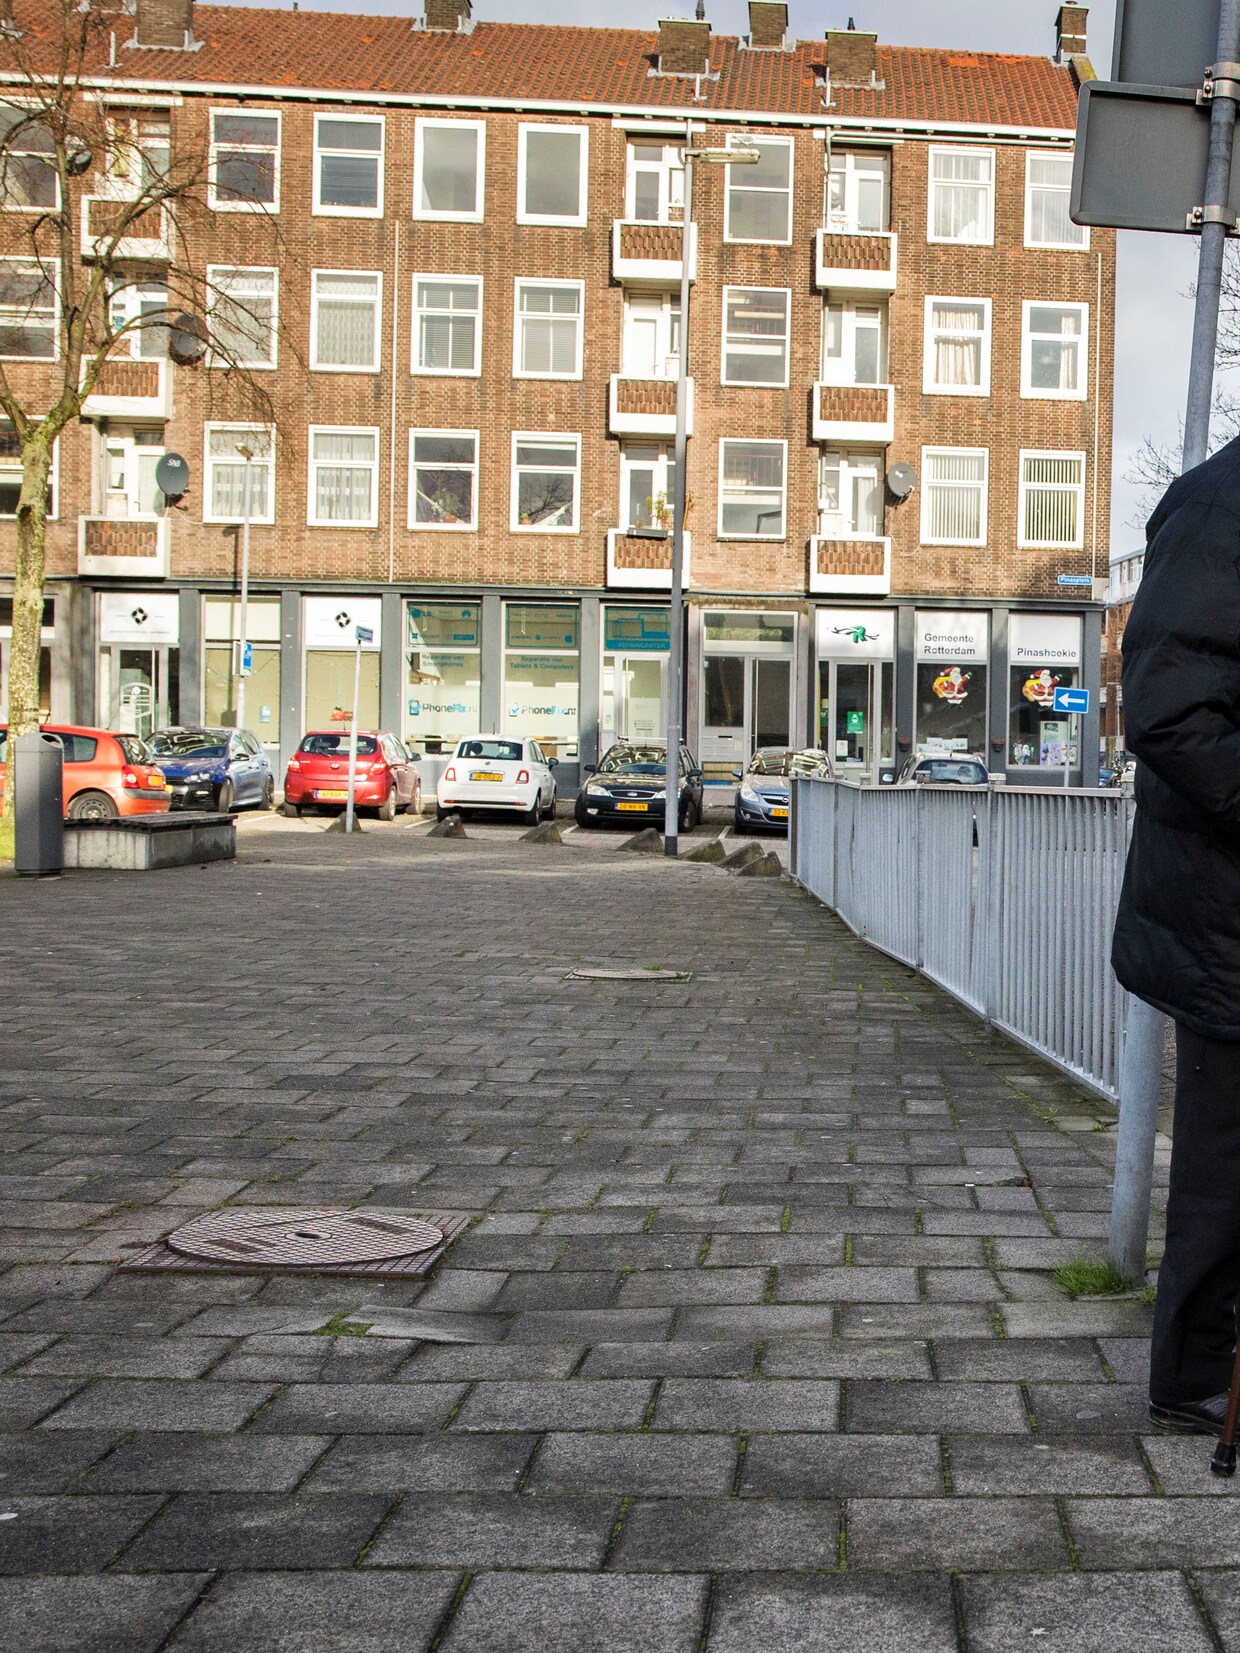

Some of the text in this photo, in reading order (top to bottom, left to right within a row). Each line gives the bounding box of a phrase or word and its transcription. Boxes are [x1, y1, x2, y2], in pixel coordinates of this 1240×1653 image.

[924, 633, 974, 643] Gemeente
[924, 645, 976, 656] Rotterdam
[1017, 647, 1077, 658] Pinashoekie
